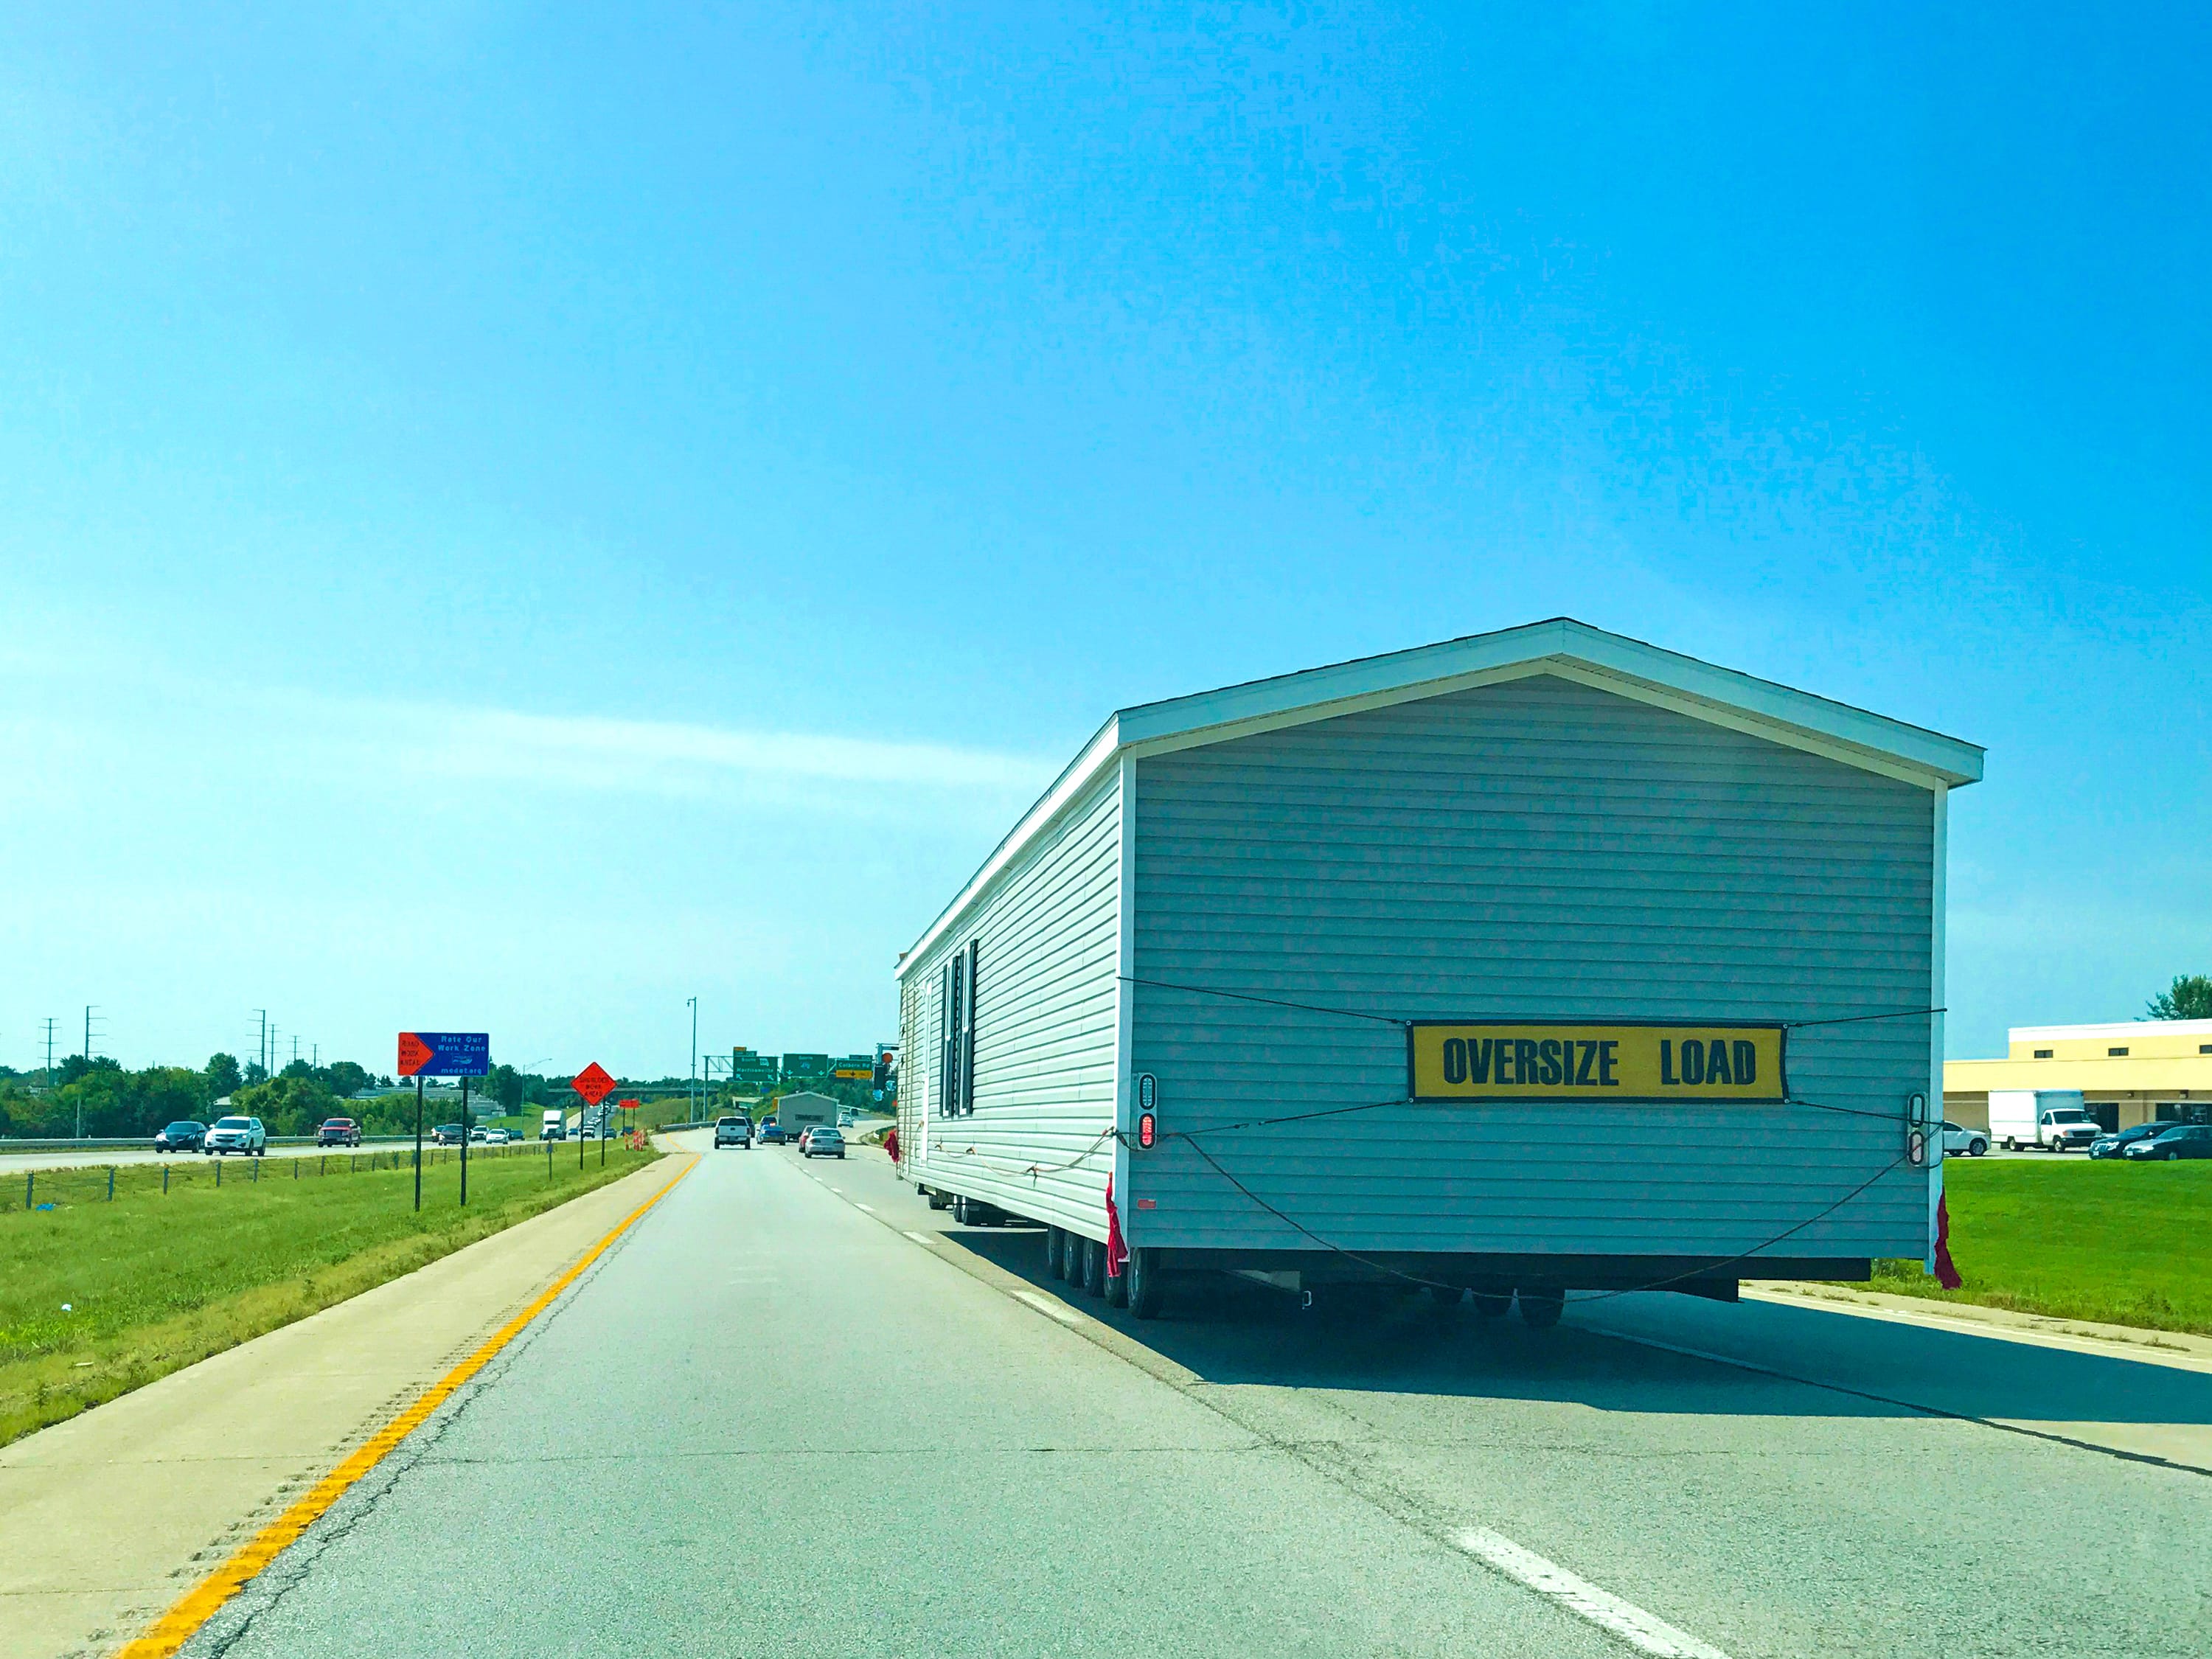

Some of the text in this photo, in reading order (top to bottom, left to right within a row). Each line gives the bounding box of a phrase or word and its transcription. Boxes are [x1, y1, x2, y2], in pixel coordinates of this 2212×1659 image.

[440, 1035, 462, 1043] Rate
[463, 1044, 486, 1052] Zone
[1442, 1037, 1756, 1086] OVERSIZE LOAD
